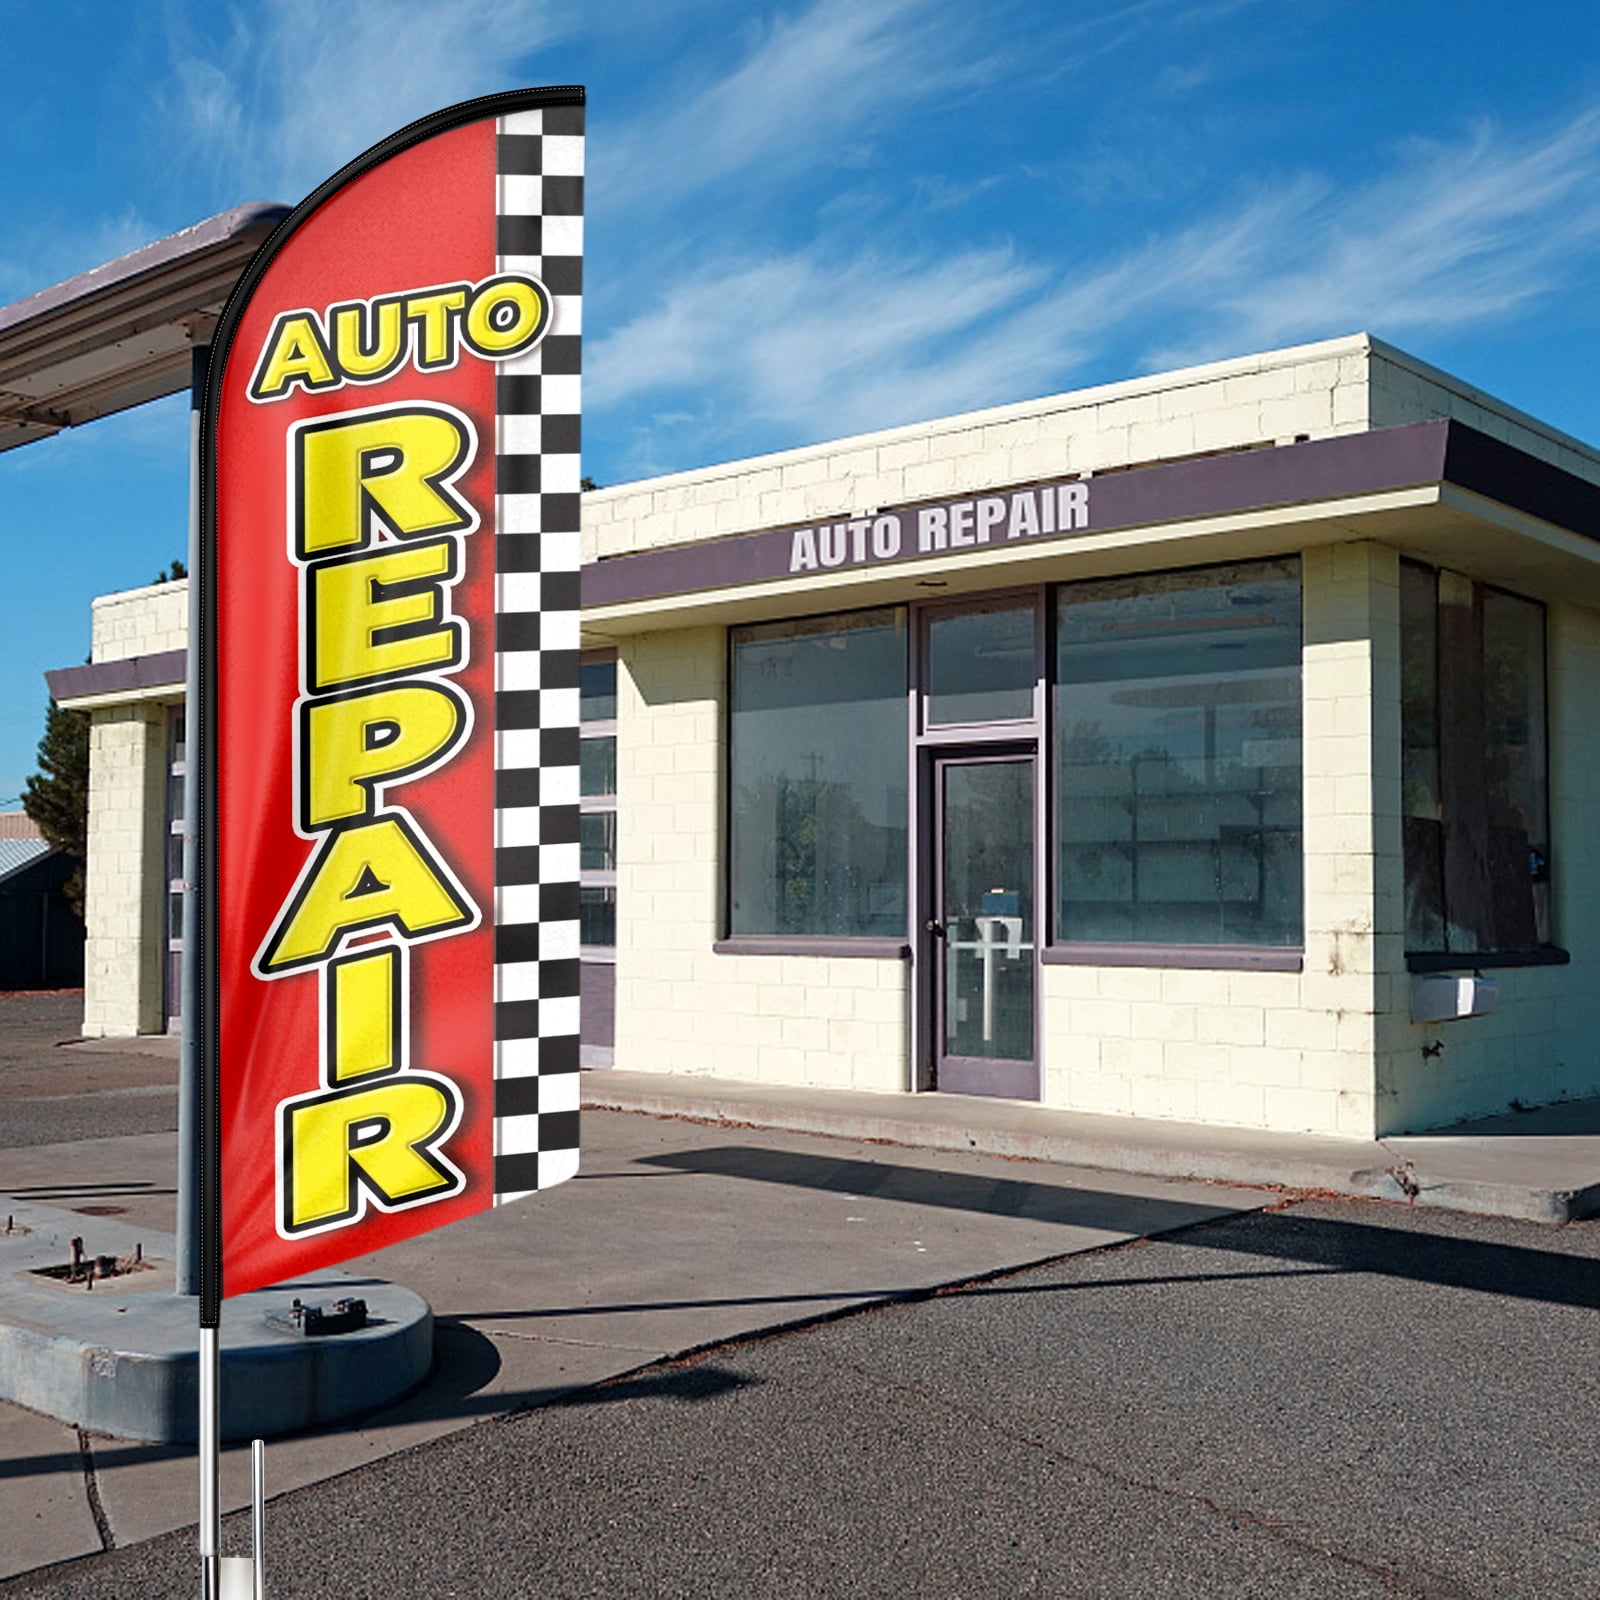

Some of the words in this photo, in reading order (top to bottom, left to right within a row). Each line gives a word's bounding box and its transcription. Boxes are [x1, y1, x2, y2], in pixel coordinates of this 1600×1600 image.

[250, 274, 550, 400] AUTO
[789, 515, 901, 573] AUTO
[917, 482, 1090, 553] REPAIR
[257, 405, 477, 1234] REPAIR
